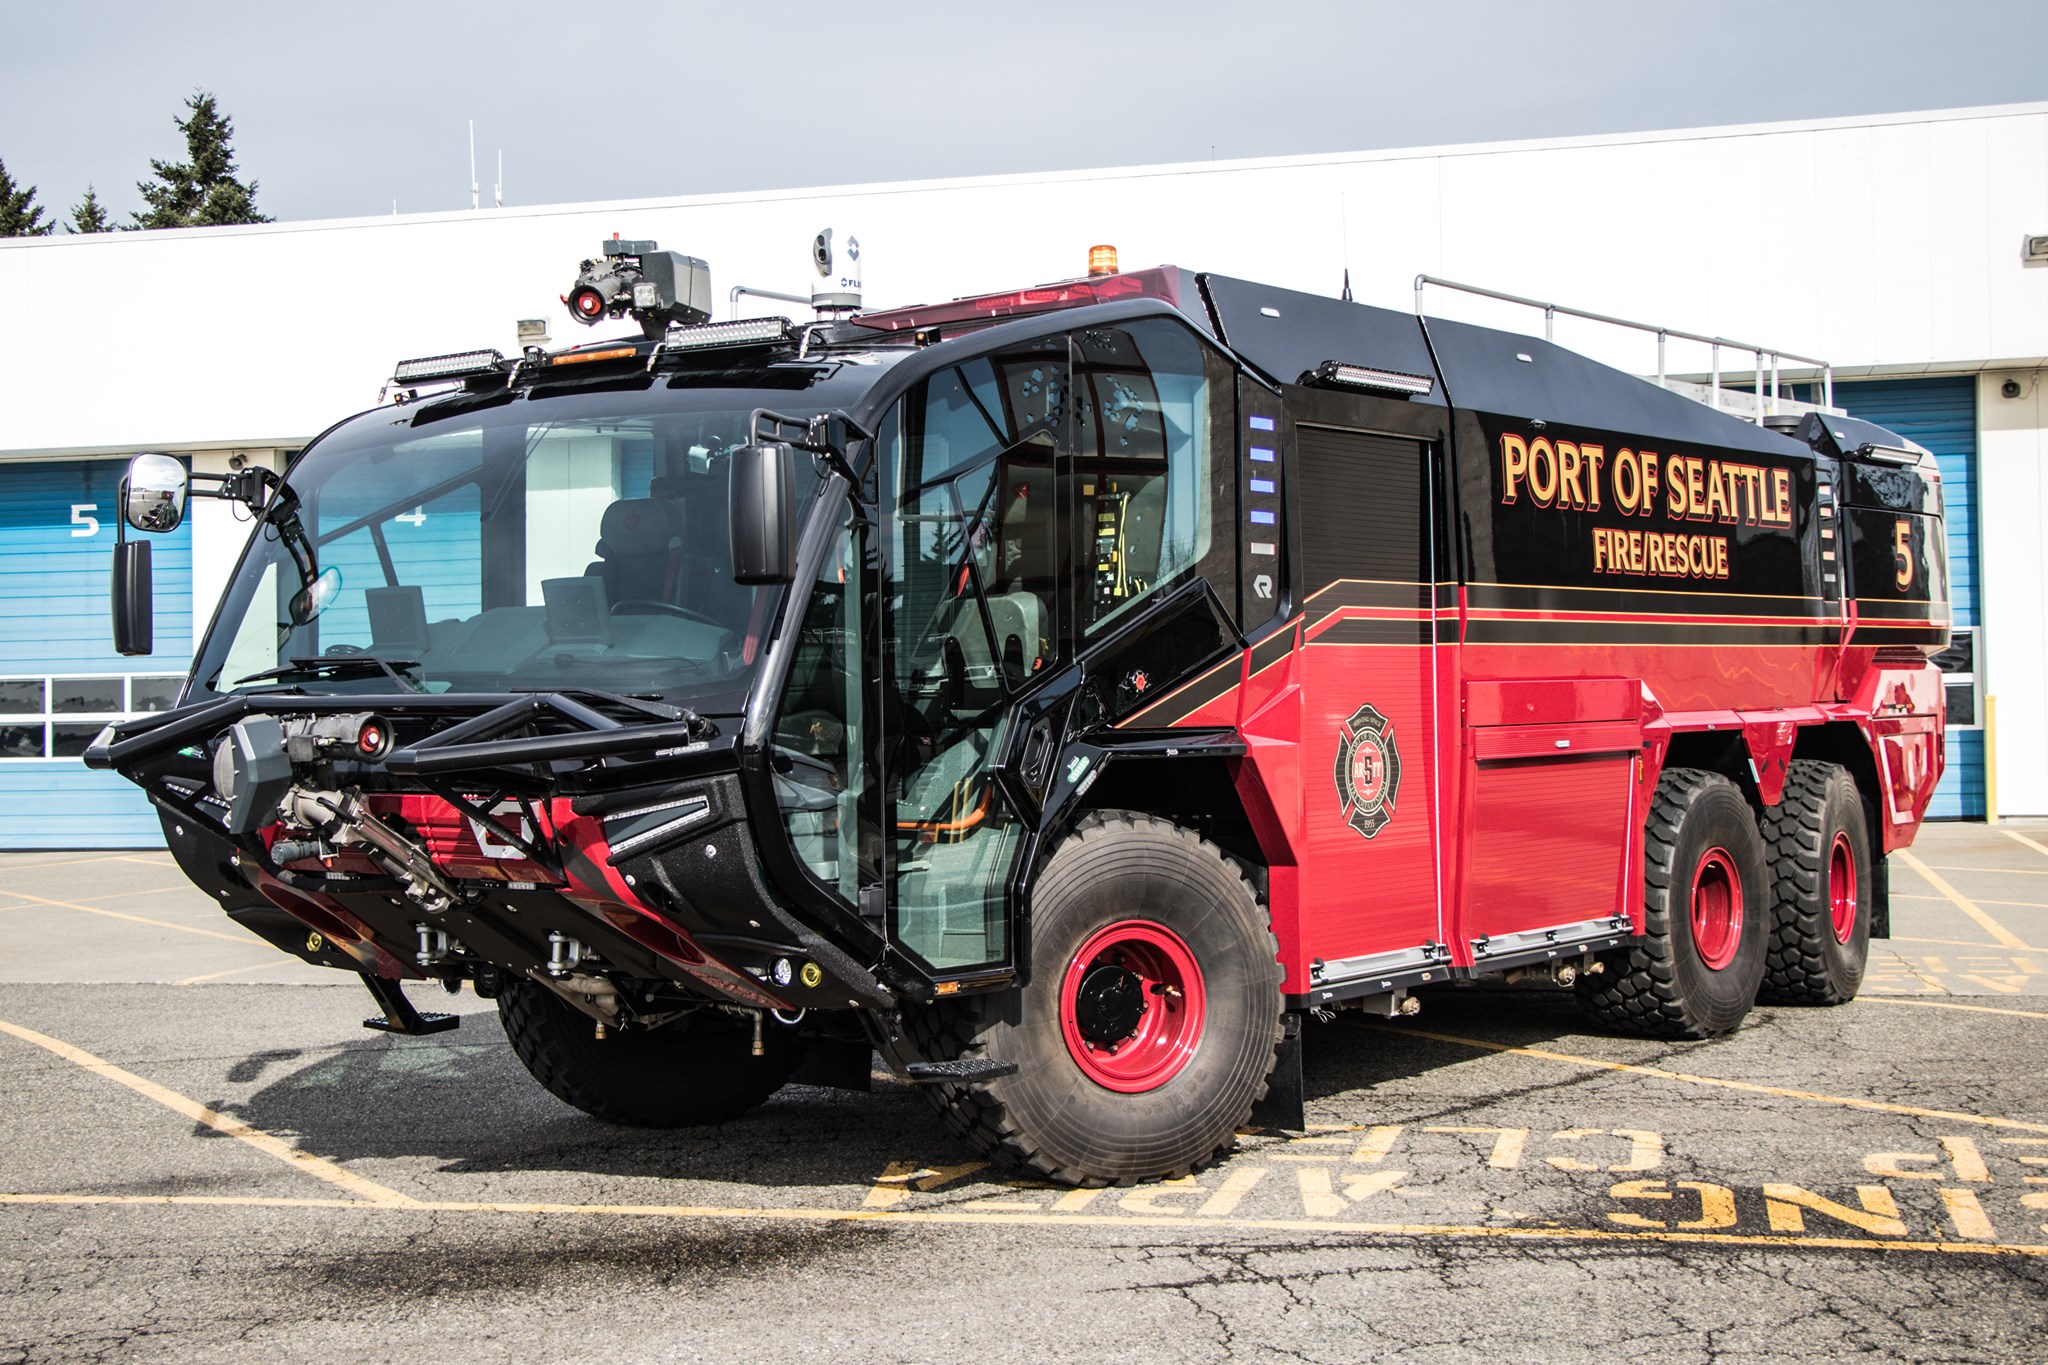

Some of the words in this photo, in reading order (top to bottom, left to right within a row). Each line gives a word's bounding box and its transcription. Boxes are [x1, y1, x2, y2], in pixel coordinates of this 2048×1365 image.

[1500, 433, 1603, 512] PORT
[1612, 447, 1658, 517] OF
[1666, 454, 1792, 529] SEATTLE
[71, 503, 100, 538] 5
[394, 504, 427, 527] 4
[1592, 528, 1729, 580] FIRE/RESCUE
[1894, 520, 1914, 592] 5
